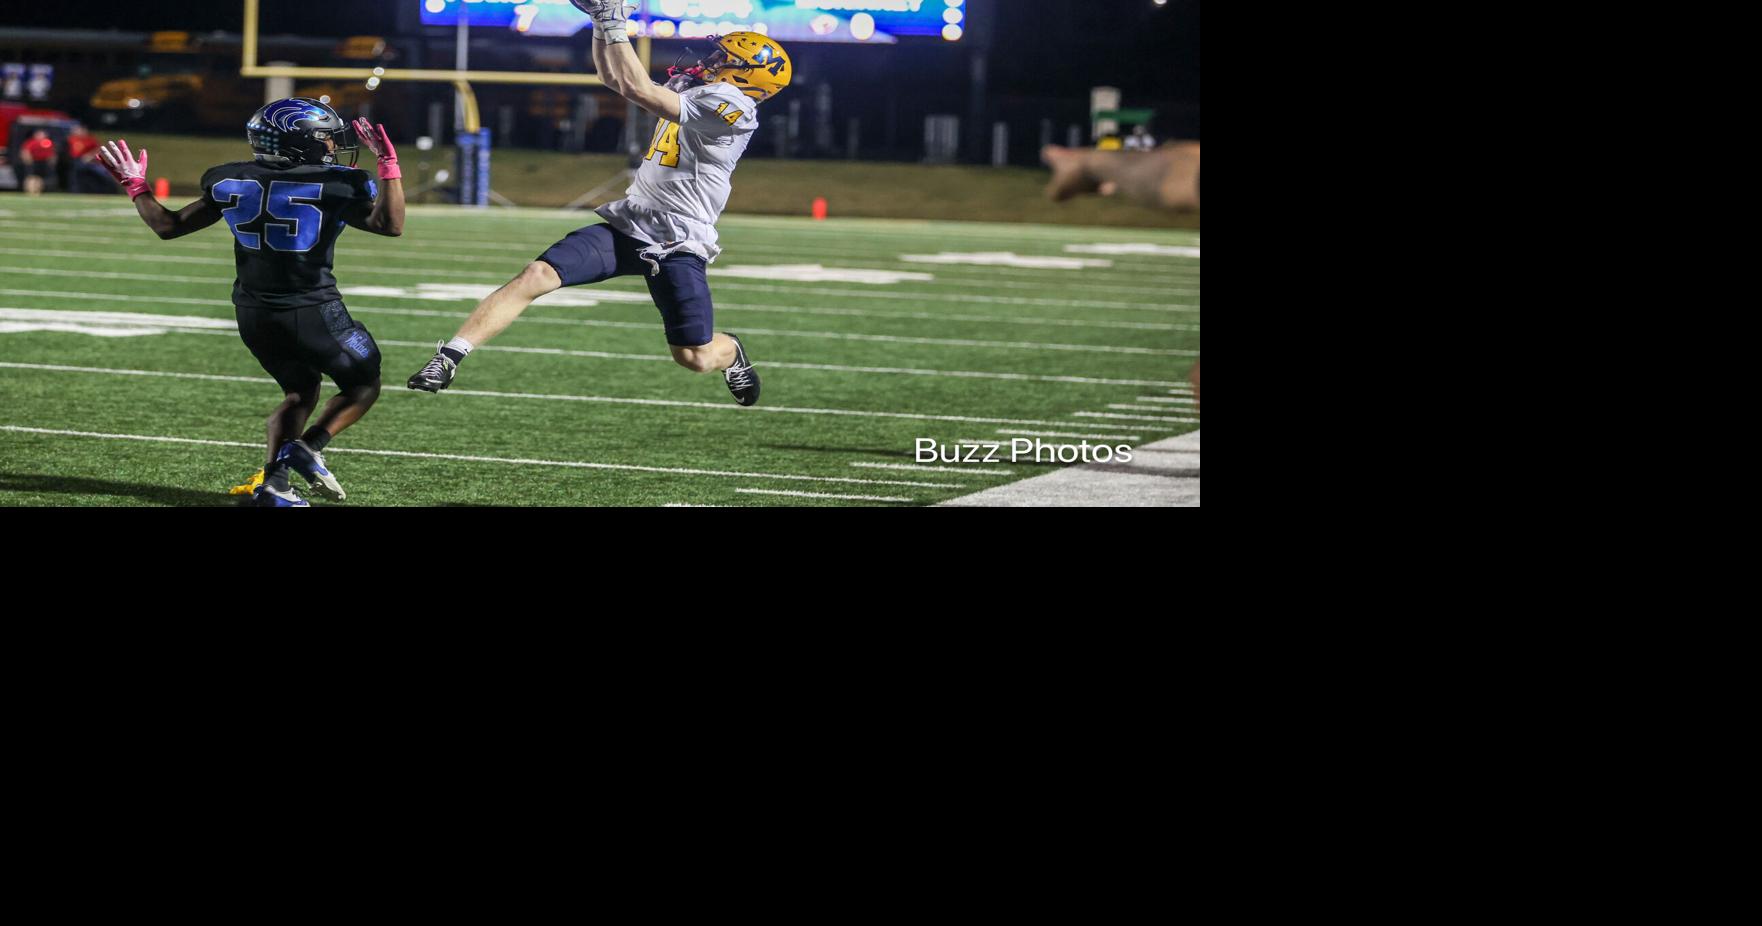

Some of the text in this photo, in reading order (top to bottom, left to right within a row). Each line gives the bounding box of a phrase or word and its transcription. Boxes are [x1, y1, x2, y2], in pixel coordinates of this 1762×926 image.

[752, 44, 786, 77] M
[714, 100, 745, 127] 14
[645, 117, 681, 169] 14
[211, 178, 324, 252] 25
